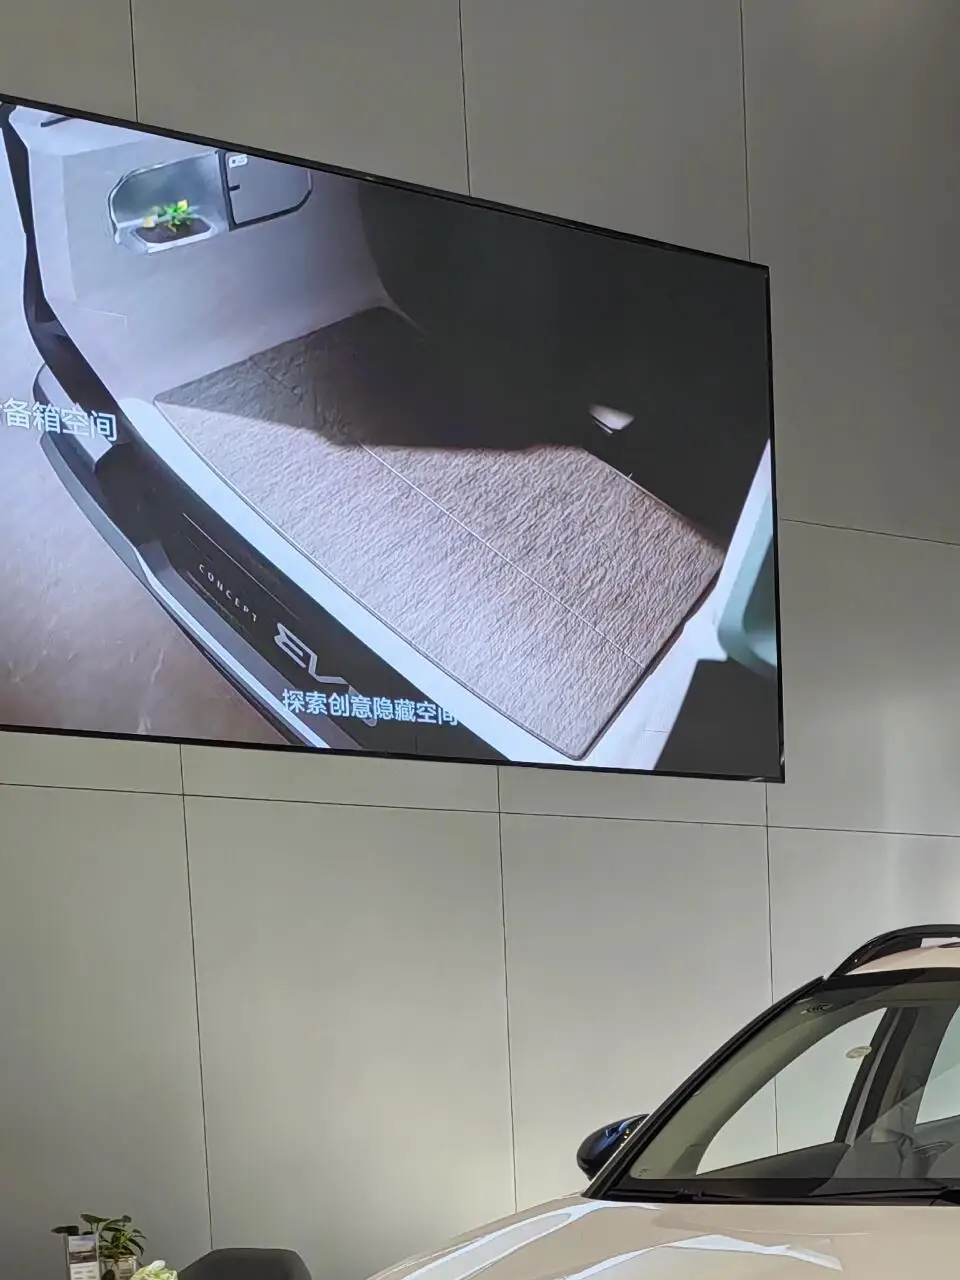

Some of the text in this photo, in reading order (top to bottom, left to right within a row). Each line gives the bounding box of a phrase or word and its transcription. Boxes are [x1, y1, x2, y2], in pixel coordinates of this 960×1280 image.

[0, 397, 117, 441] 备箱空间
[198, 563, 258, 623] CONCEPT
[274, 622, 349, 685] EV
[282, 688, 459, 727] 探索创意隐藏空间
